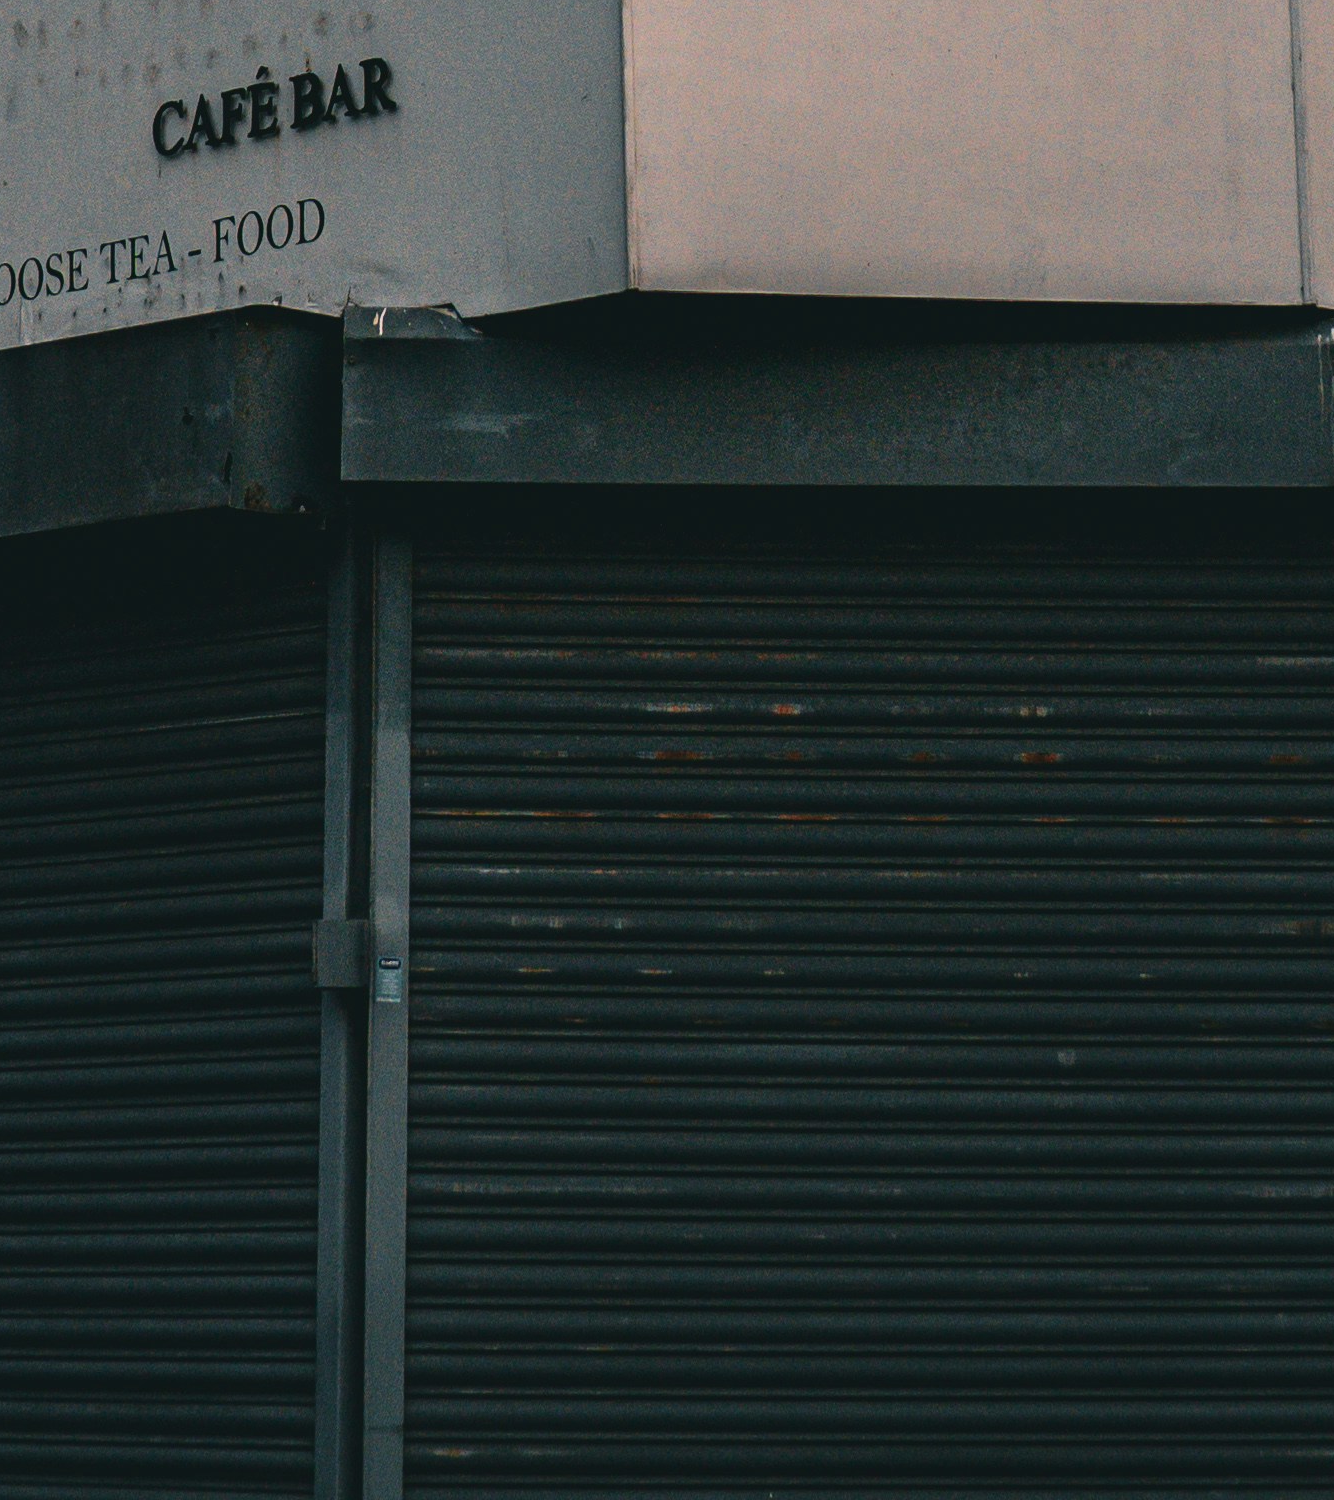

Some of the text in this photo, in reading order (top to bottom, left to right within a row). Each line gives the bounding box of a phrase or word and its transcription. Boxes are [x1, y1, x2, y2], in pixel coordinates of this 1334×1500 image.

[152, 57, 399, 161] CAFÉ BAR
[99, 231, 178, 285] TEA
[213, 197, 326, 264] FOOD
